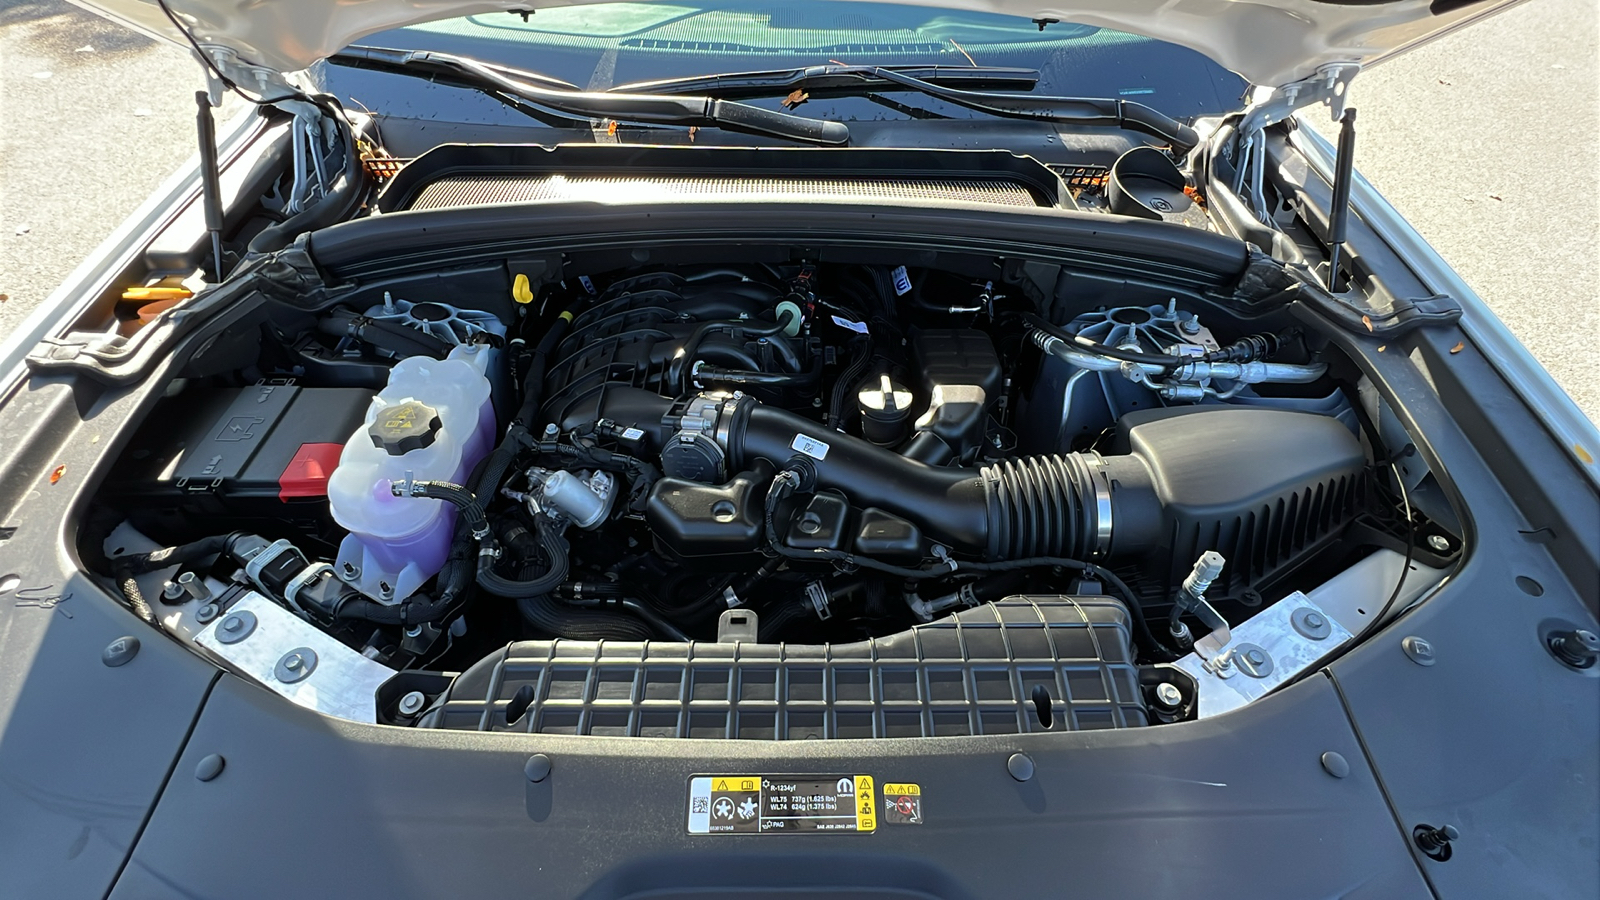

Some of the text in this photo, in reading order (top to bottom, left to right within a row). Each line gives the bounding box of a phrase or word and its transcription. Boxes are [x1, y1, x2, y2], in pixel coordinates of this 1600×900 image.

[770, 784, 796, 792] R-1234yf
[825, 795, 837, 803] lbs)
[791, 803, 806, 811] 624g
[806, 803, 825, 811] (1.375
[825, 803, 837, 811] lbs)
